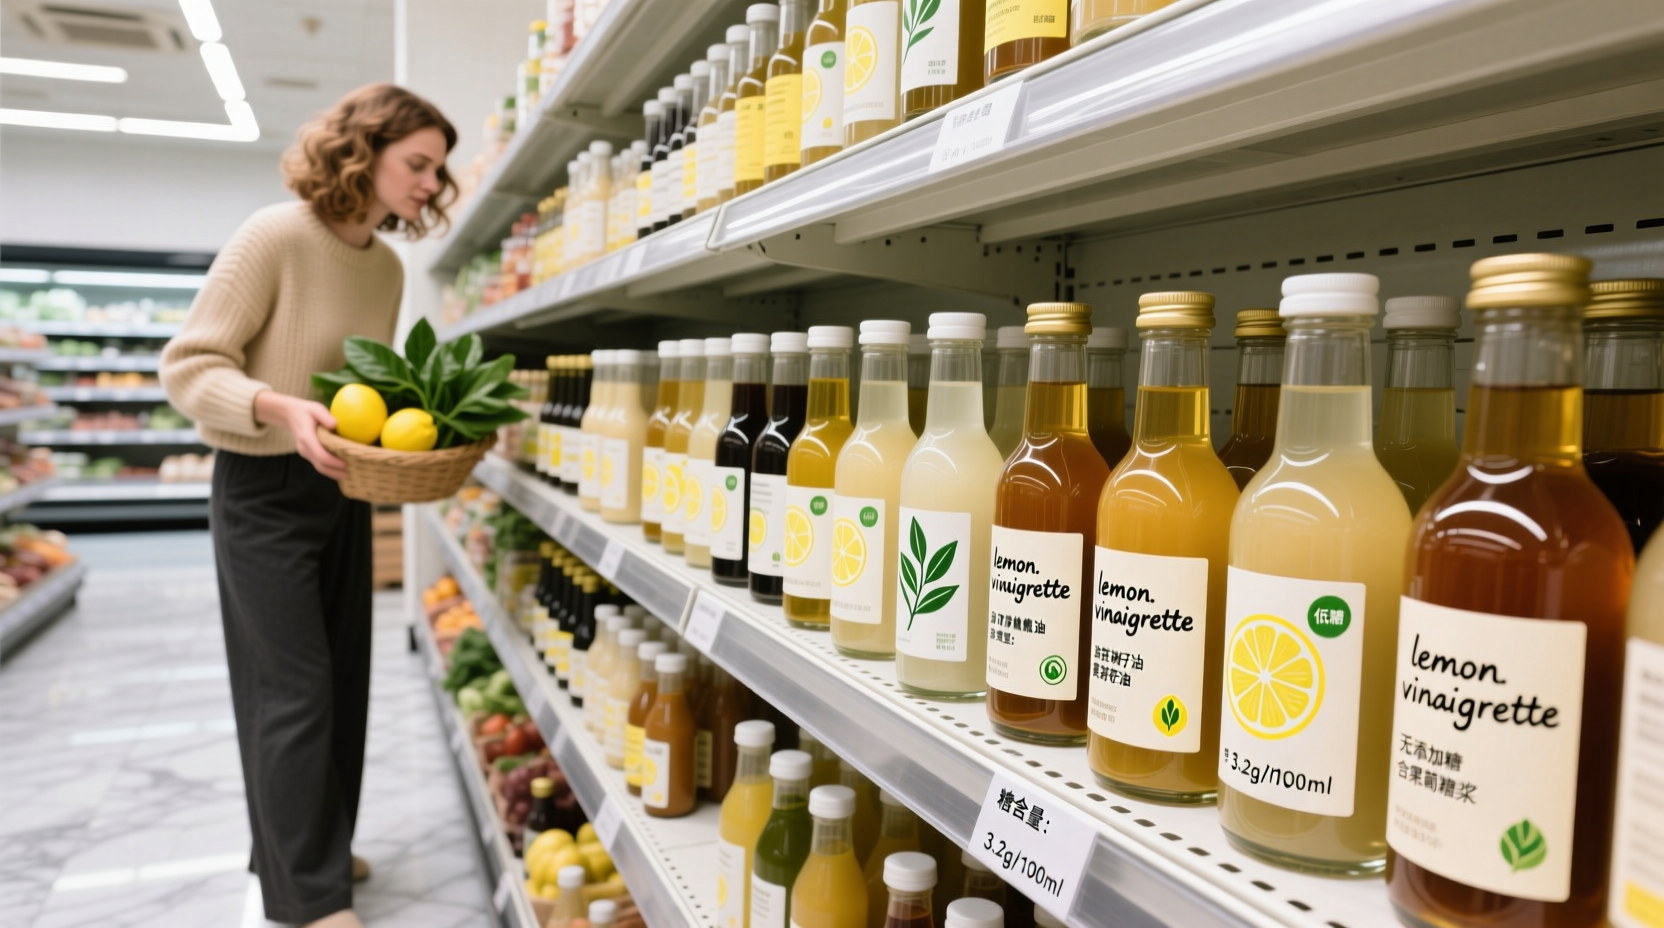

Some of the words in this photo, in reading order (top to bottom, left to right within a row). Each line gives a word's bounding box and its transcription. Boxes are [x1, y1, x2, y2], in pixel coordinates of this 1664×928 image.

[1098, 570, 1155, 603] lemon.
[1094, 601, 1194, 636] vinaigrette
[1402, 677, 1560, 731] vinaigrette
[983, 832, 1064, 897] 3.2g/100ml
